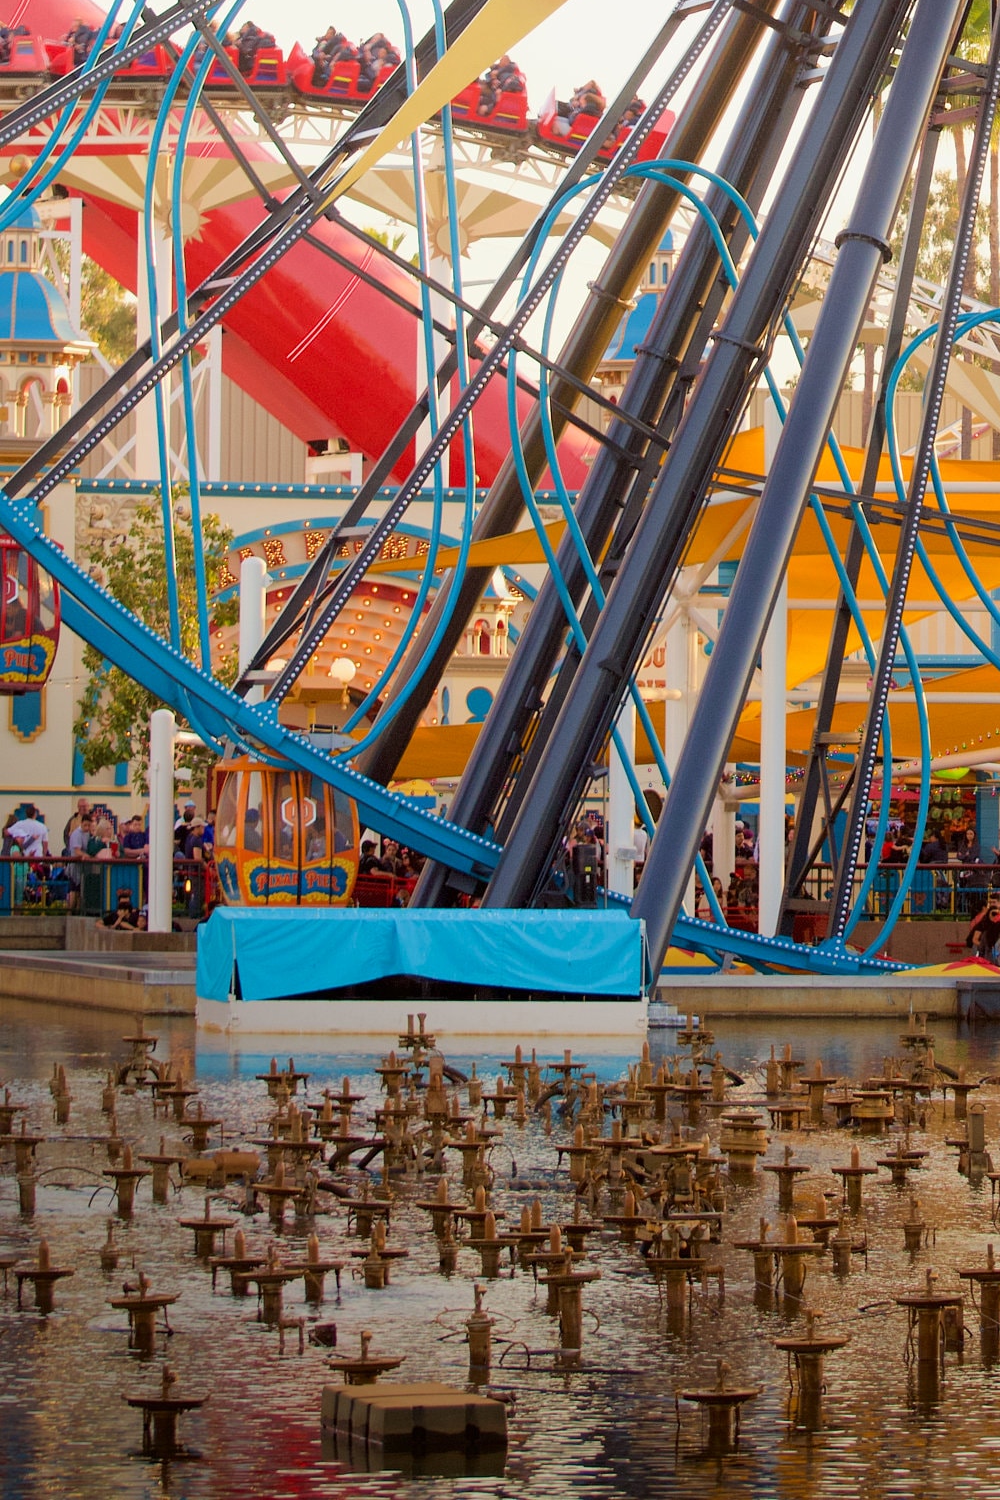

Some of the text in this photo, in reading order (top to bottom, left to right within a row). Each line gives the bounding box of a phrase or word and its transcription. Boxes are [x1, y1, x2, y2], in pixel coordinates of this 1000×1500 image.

[4, 648, 38, 671] PIER
[255, 870, 340, 892] PIXAR PIER
